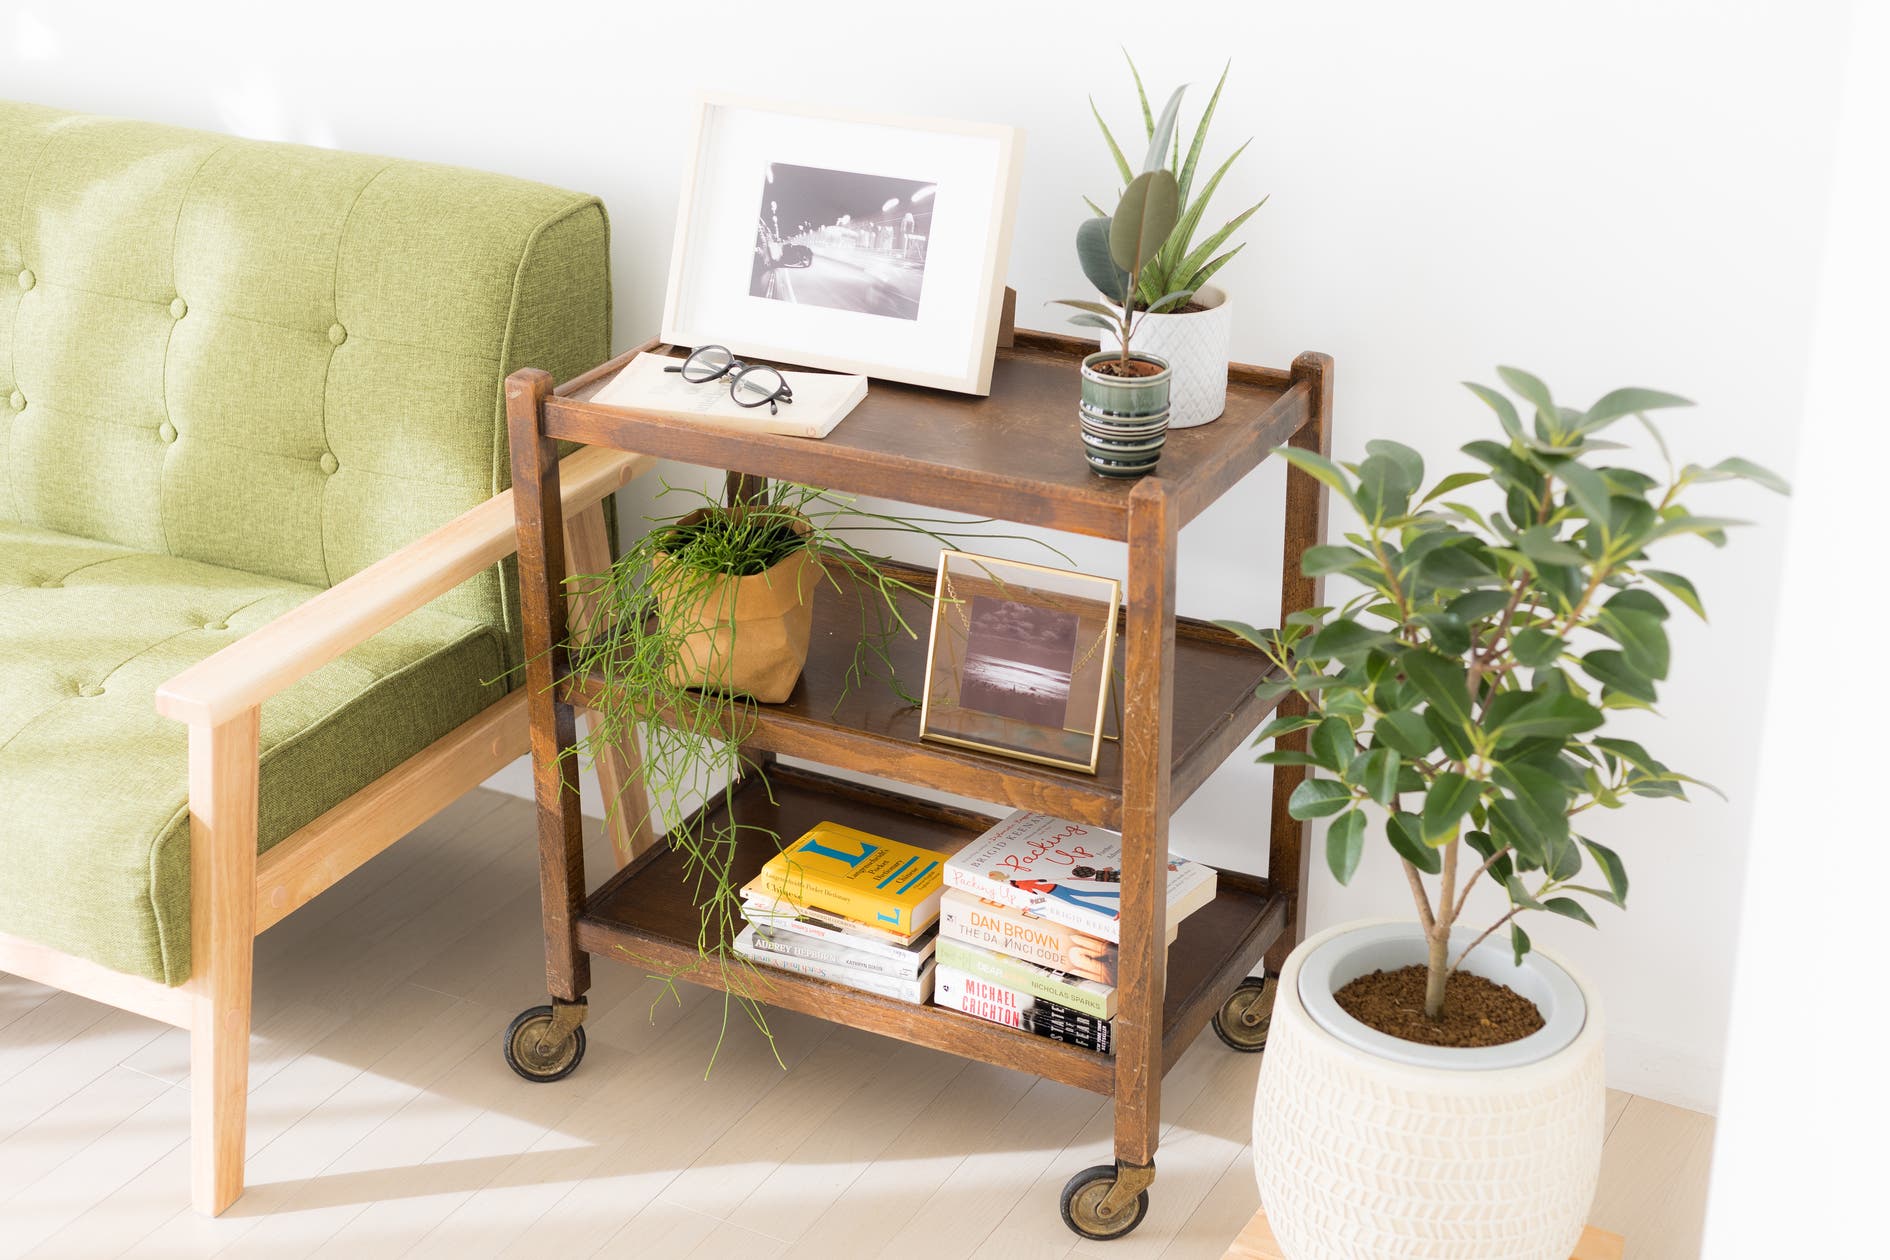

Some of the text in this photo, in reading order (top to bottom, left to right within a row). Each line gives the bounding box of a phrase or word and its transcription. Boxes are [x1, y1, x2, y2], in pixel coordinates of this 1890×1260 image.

[798, 839, 878, 867] L
[971, 841, 1007, 868] BRIGID
[1006, 814, 1046, 840] KEENAN
[996, 825, 1087, 872] Packing
[868, 860, 889, 874] Pocket
[1045, 846, 1094, 865] Up
[766, 871, 804, 888] Langensheidt's
[873, 860, 904, 881] Dictionary
[896, 867, 918, 884] Chinese
[953, 868, 994, 899] Packing
[1000, 886, 1016, 904] Up
[877, 907, 901, 926] L
[1086, 919, 1118, 935] KEENA
[960, 924, 1066, 965] THE DA VINCI CODE
[970, 911, 1060, 951] DAN BROWN
[755, 939, 837, 962] AUDREY HEPBURN
[965, 979, 1017, 1008] MICHAEL
[1031, 981, 1101, 1010] NICHOLAS SPARKS
[962, 996, 1020, 1028] CRICHTON
[1050, 1005, 1065, 1042] STATE
[1065, 1021, 1075, 1033] OF
[1075, 1017, 1090, 1047] FEAR
